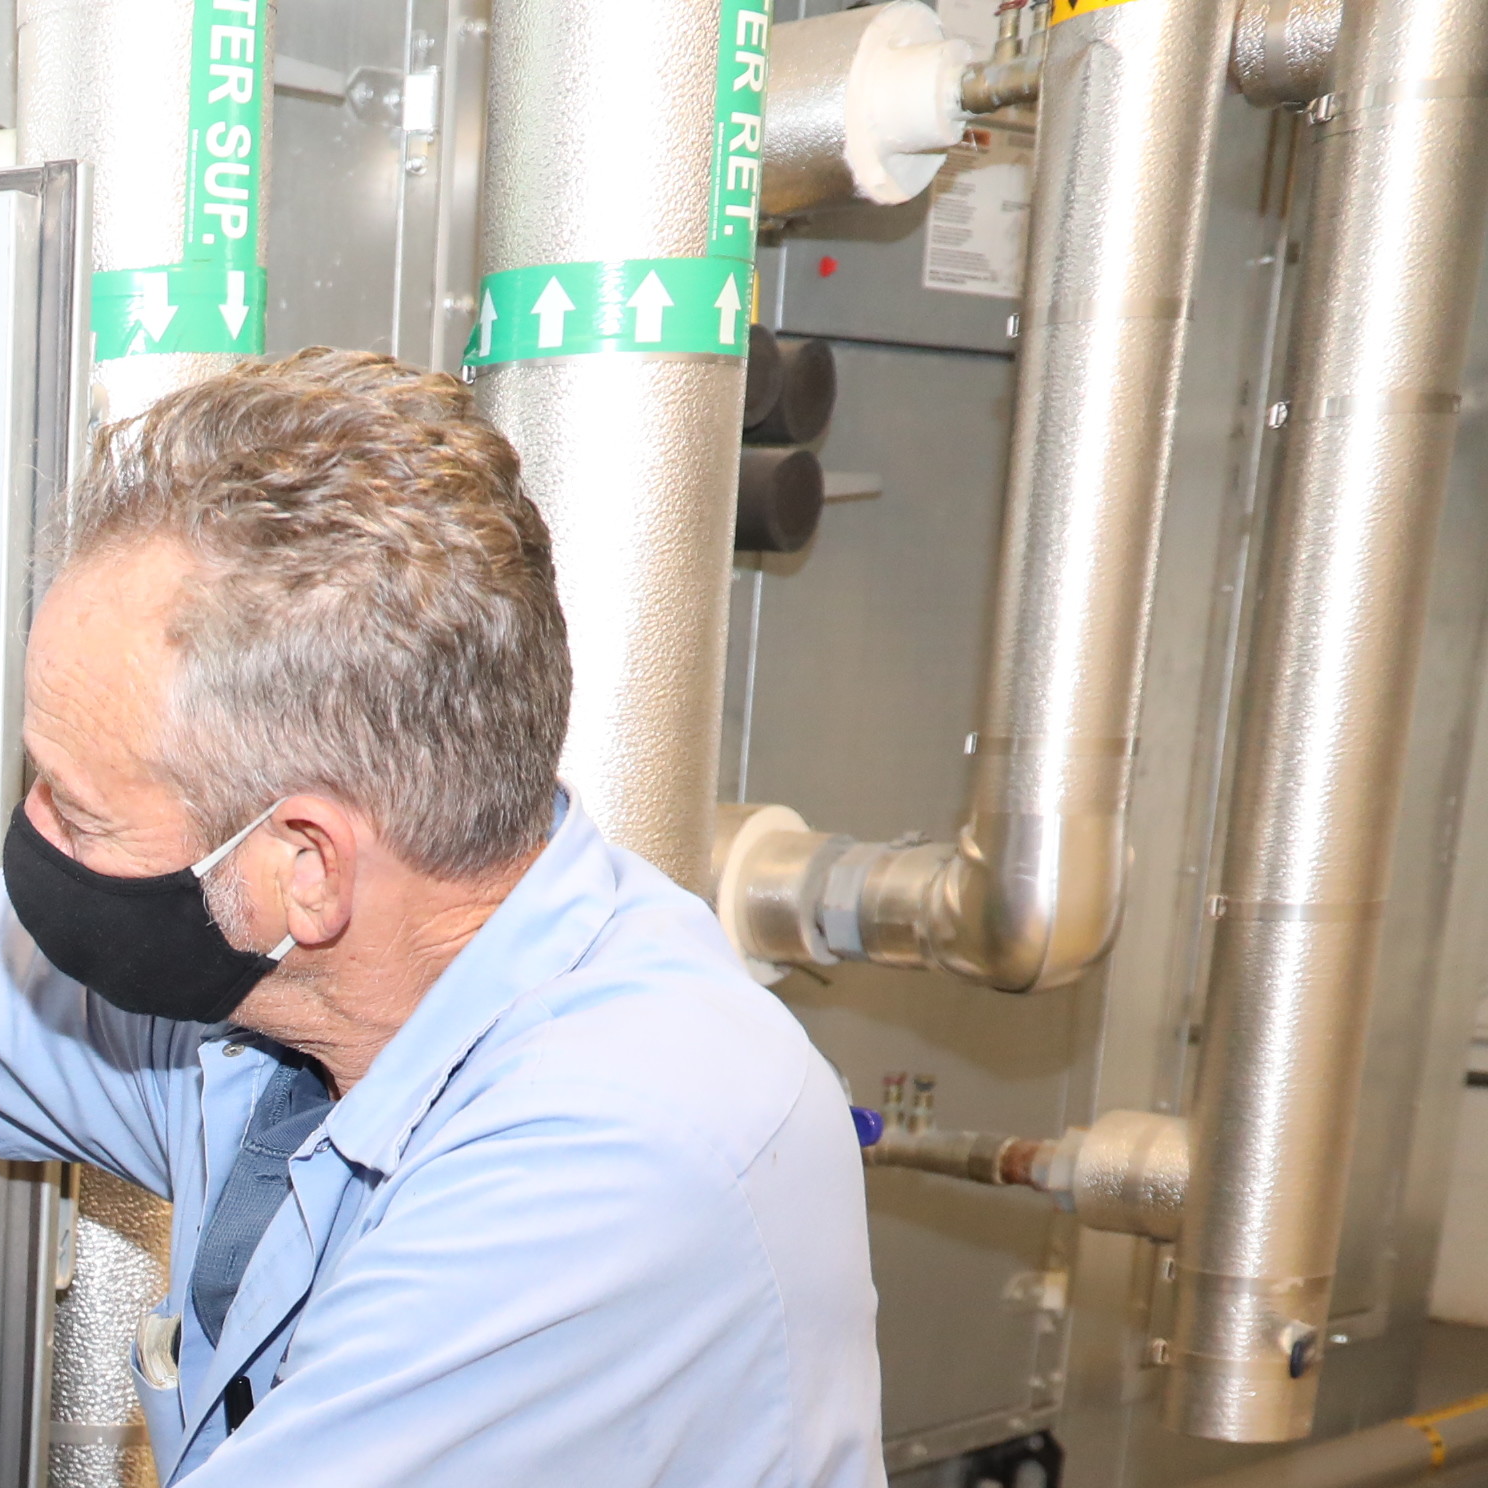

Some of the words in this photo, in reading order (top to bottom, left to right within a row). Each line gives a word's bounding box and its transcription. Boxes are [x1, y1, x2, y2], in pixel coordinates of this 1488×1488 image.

[733, 0, 769, 92] ER
[202, 121, 252, 244] SUP.
[724, 111, 761, 235] RET.
